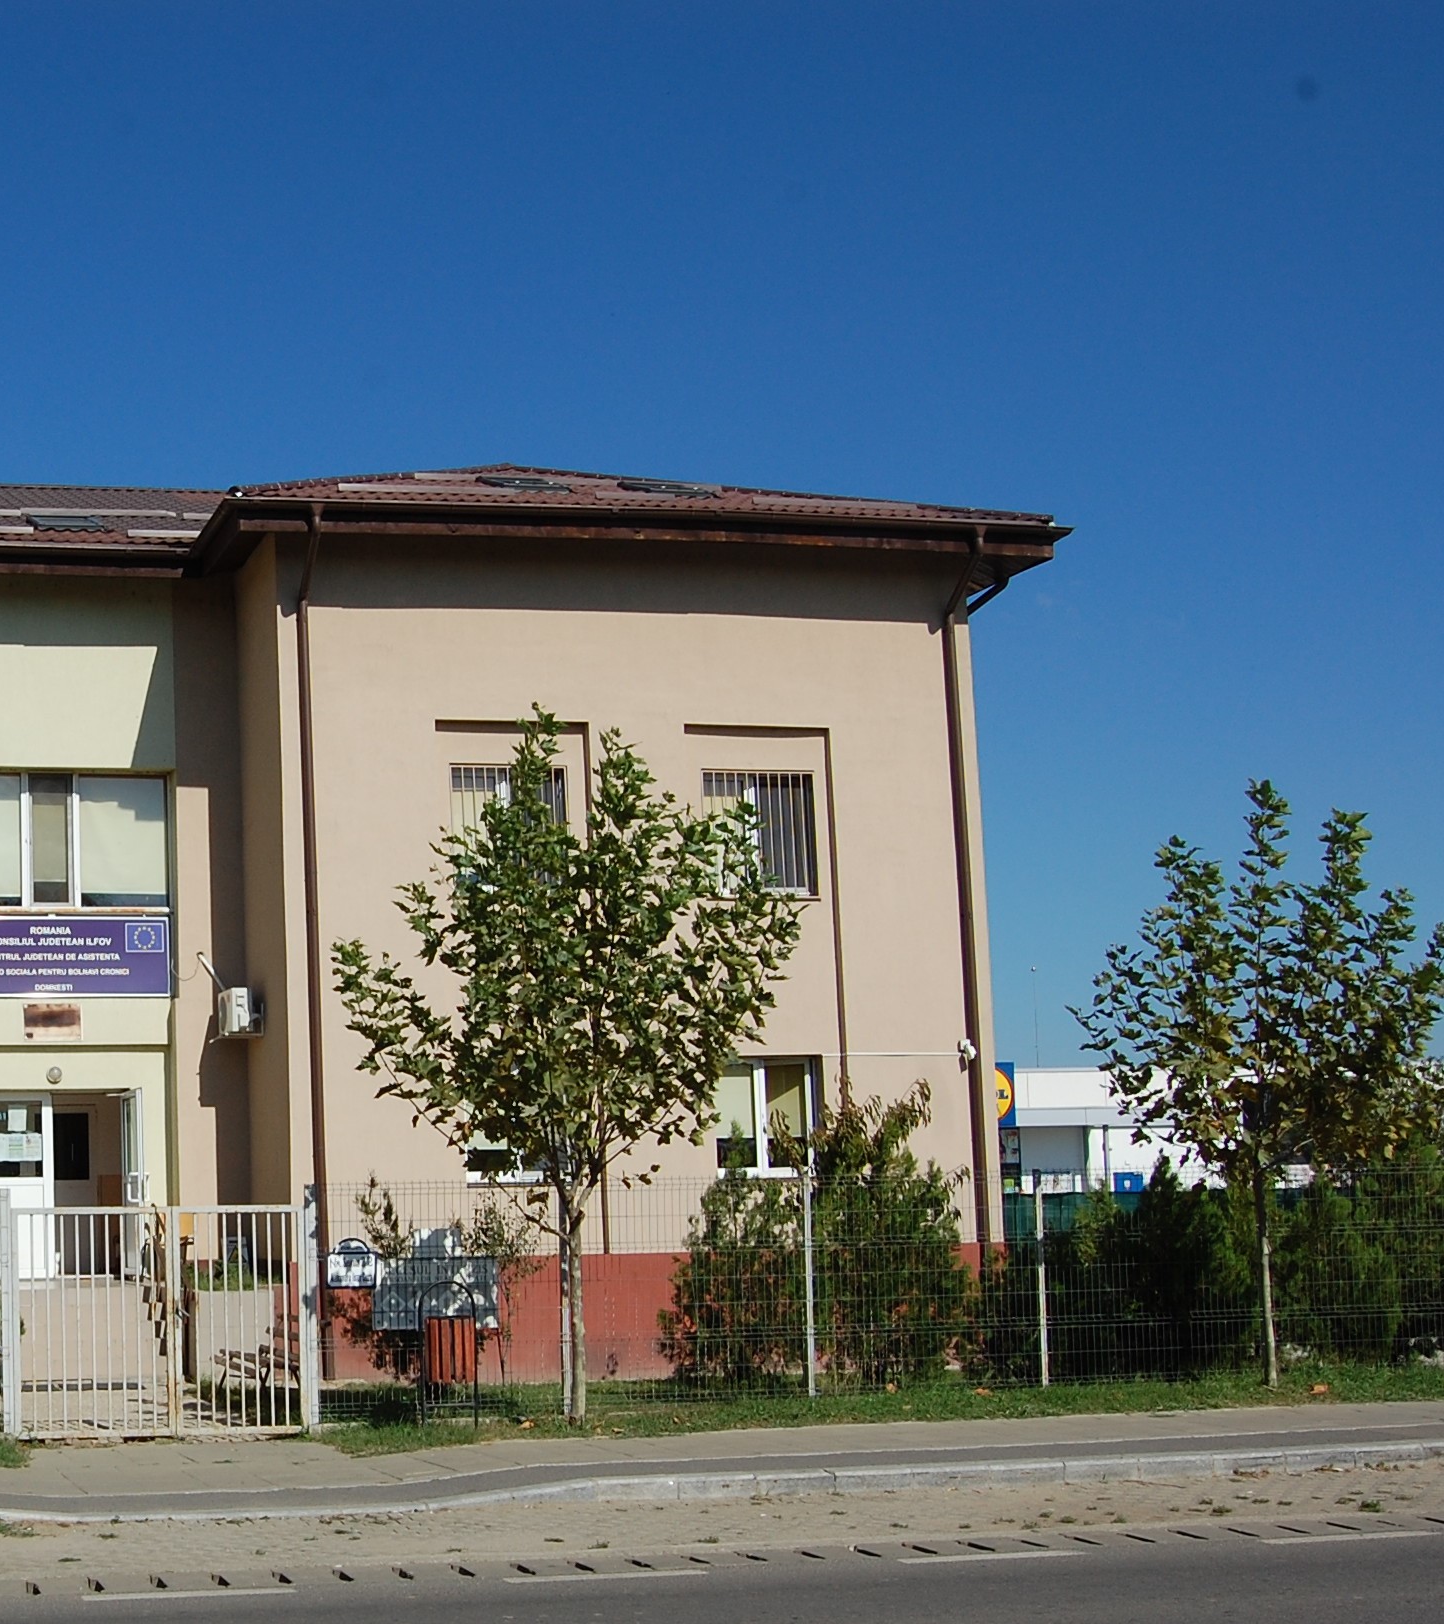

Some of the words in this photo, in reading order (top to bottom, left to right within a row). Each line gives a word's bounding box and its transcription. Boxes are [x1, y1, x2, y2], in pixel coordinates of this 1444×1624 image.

[29, 926, 72, 935] ROMANIA
[37, 937, 84, 946] JUDETEAN
[85, 937, 112, 946] ILFOV
[22, 952, 64, 961] JUDETEAN
[65, 952, 77, 961] DE
[77, 952, 121, 961] ASISTENTA
[5, 967, 37, 976] SOCIALA
[37, 967, 67, 976] PENTRU
[67, 967, 99, 976] BOLNAVI
[99, 967, 130, 976] CRONICI
